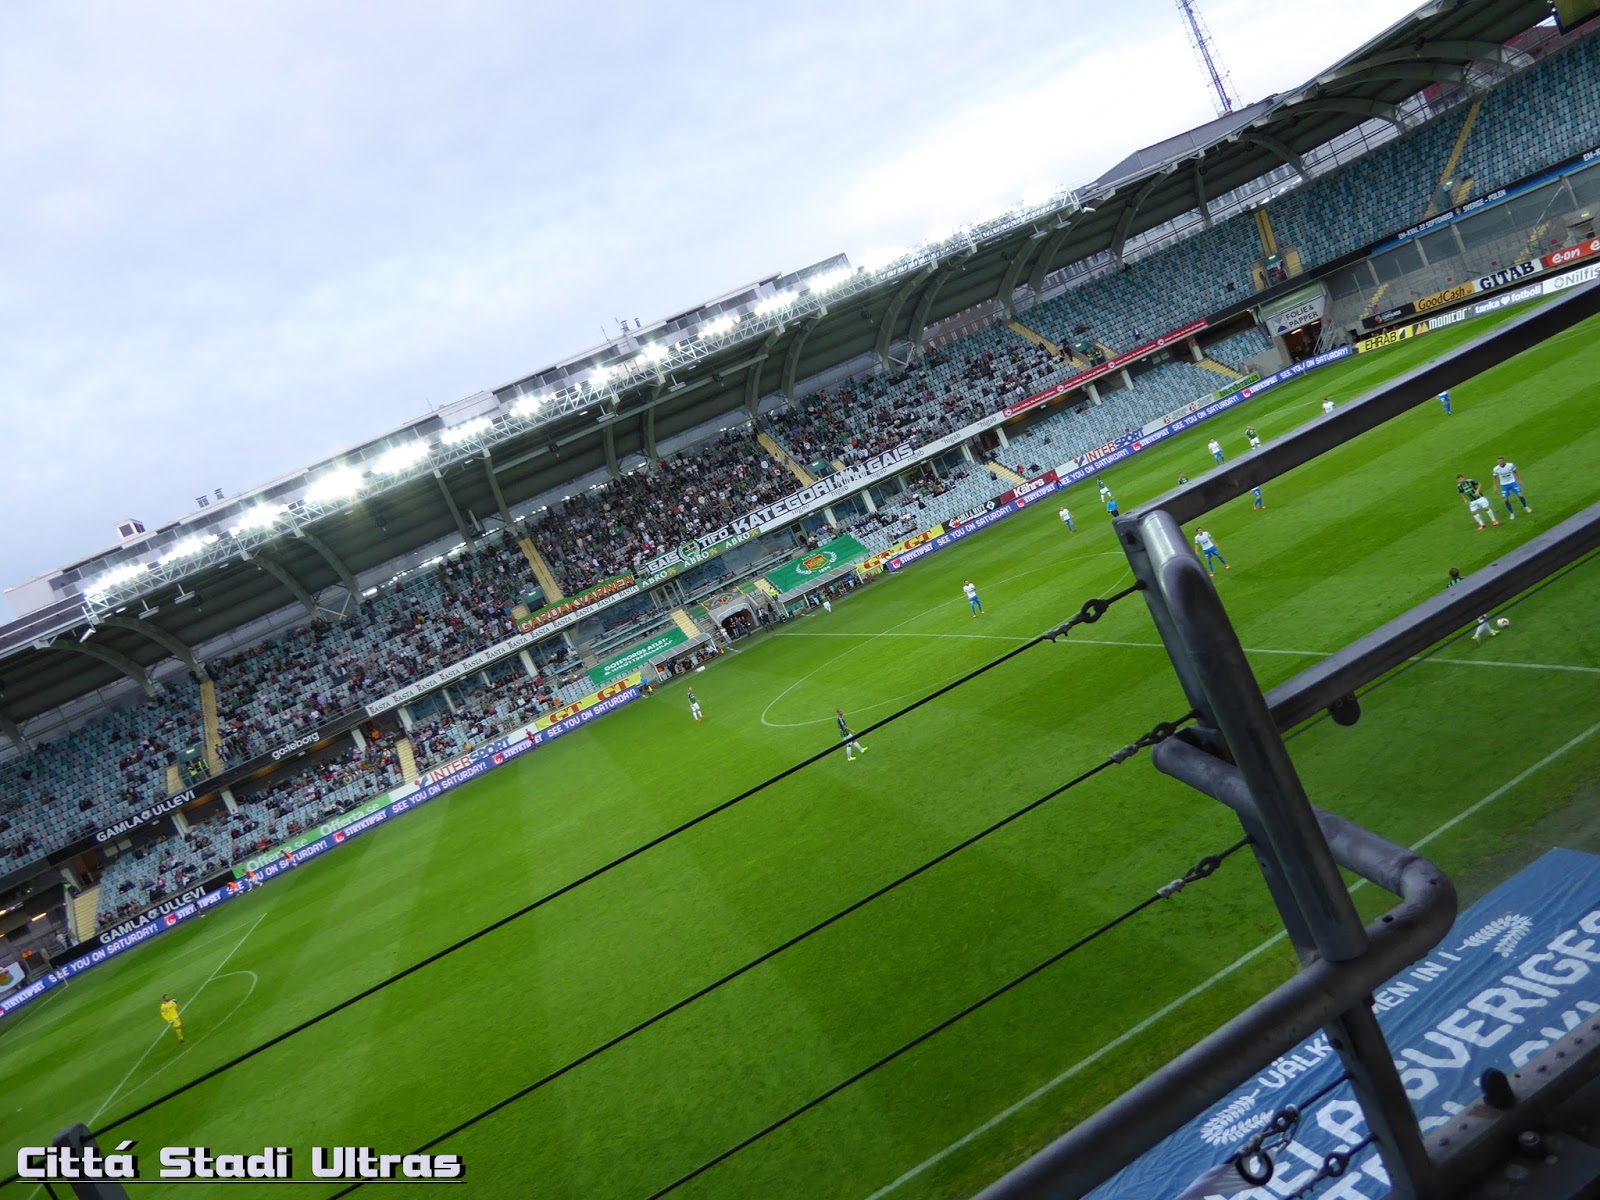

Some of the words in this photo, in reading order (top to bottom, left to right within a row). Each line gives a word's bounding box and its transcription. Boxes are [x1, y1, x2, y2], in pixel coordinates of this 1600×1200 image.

[1462, 198, 1485, 213] SVERIGE
[1487, 189, 1507, 202] POLEN
[1425, 212, 1454, 228] SEPTEMBER
[1480, 261, 1535, 290] GITAB
[1418, 286, 1465, 310] GoodCash
[1475, 299, 1500, 314] tanka
[1511, 285, 1541, 302] fotboll
[1285, 306, 1308, 320] FOLIE
[1289, 311, 1319, 328] PAPPER
[1429, 307, 1467, 330] monitor
[1365, 331, 1397, 351] EHRAB
[1280, 369, 1293, 379] SEE
[1291, 362, 1305, 373] YOU
[1306, 358, 1315, 368] ON
[1315, 347, 1348, 366] SATURDAY!
[1172, 421, 1185, 431] SEE
[1184, 415, 1198, 425] YOU
[1197, 411, 1207, 420] ON
[1206, 395, 1239, 414] SATURDAY!
[1085, 427, 1144, 463] INTERSPORT
[1071, 469, 1085, 480] YOU
[1085, 464, 1095, 473] ON
[1094, 448, 1129, 469] SATURDAY!
[699, 529, 729, 547] TIFO
[732, 478, 834, 534] KATEGORI
[867, 443, 914, 473] GAIS
[1013, 477, 1045, 498] Kährs
[725, 531, 751, 549] ABRO
[900, 542, 934, 564] STRYKTIPSET
[936, 534, 951, 546] SEE
[950, 528, 965, 540] YOU
[965, 522, 976, 532] ON
[975, 504, 1012, 527] SATURDAY!
[904, 530, 932, 550] GT
[648, 551, 680, 572] GAIS
[684, 550, 709, 568] ABRO
[642, 570, 668, 588] ABRO
[597, 596, 616, 608] RASTA
[618, 585, 638, 597] RASTA
[553, 616, 573, 629] RASTA
[575, 606, 595, 619] RASTA
[509, 637, 529, 650] RASTA
[531, 626, 551, 639] RASTA
[464, 658, 484, 671] RASTA
[487, 647, 506, 660] RASTA
[418, 679, 438, 693] RASTA
[441, 668, 461, 682] RASTA
[395, 690, 415, 704] RASTA
[597, 678, 630, 701] GT
[371, 701, 391, 715] RASTA
[547, 724, 563, 738] SEE
[563, 716, 580, 728] YOU
[581, 710, 593, 721] ON
[593, 689, 637, 715] SATURDAY!
[550, 701, 583, 723] GT
[503, 733, 543, 759] STRYKTIPET
[429, 736, 510, 783] INTERSPORT
[345, 810, 388, 837] STRYKTIPSET
[392, 799, 409, 814] SEE
[409, 792, 427, 805] YOU
[428, 785, 441, 796] ON
[443, 761, 488, 789] SATURDAY!
[96, 815, 143, 842] GAMLA
[152, 790, 196, 816] ULLEVI
[246, 838, 308, 872] Offera.se
[177, 890, 222, 920] STRYTIPSET
[265, 864, 279, 876] ON
[100, 915, 151, 944] GAMLA
[161, 886, 207, 915] ULLEVI
[2, 980, 45, 1011] STRYKTIPSET
[48, 966, 70, 983] SEE
[70, 956, 91, 972] YOU
[92, 949, 106, 962] ON
[107, 924, 159, 955] SATURDAY!
[1410, 961, 1448, 982] IN
[1437, 951, 1462, 961] I
